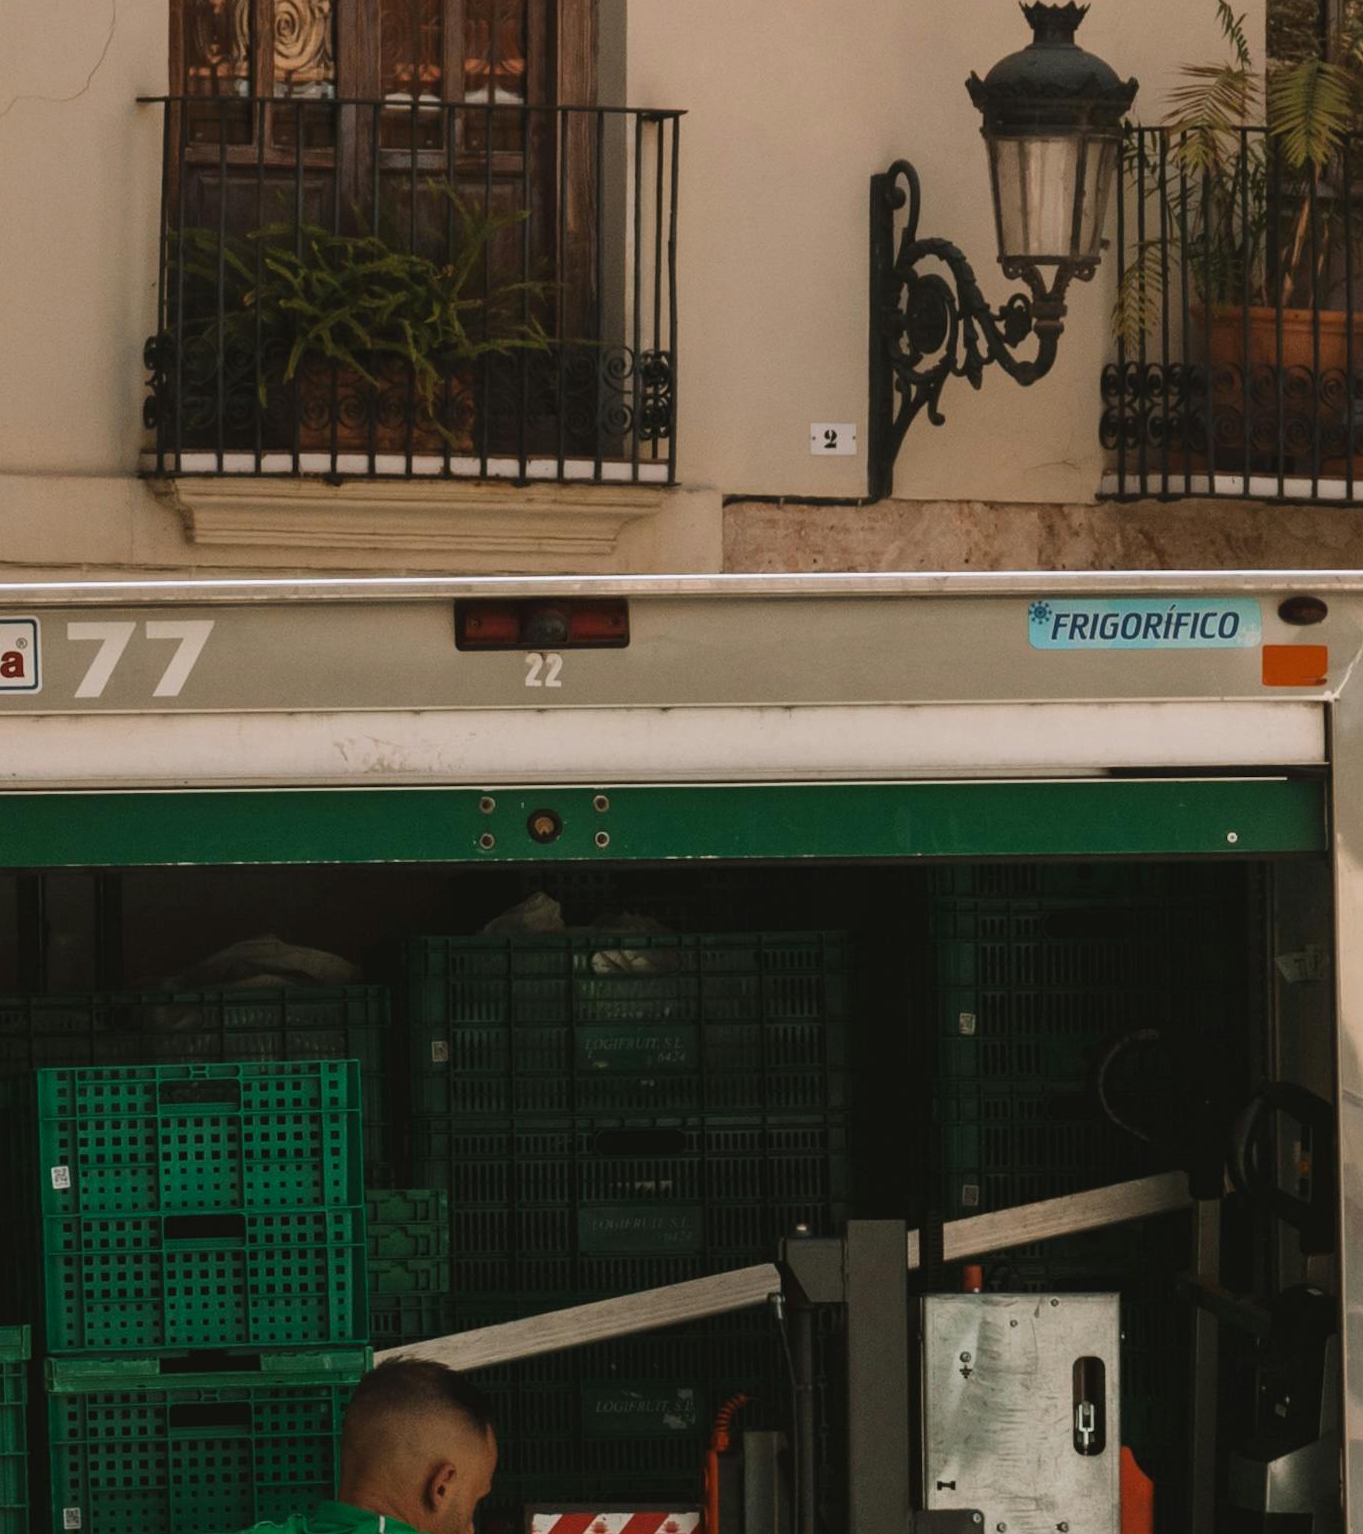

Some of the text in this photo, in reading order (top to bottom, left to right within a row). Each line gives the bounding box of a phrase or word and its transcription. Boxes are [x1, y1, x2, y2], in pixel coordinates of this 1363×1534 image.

[824, 429, 838, 449] 2
[1051, 604, 1240, 640] FRIGORÍFICO
[67, 620, 215, 698] 77
[525, 652, 563, 687] 22
